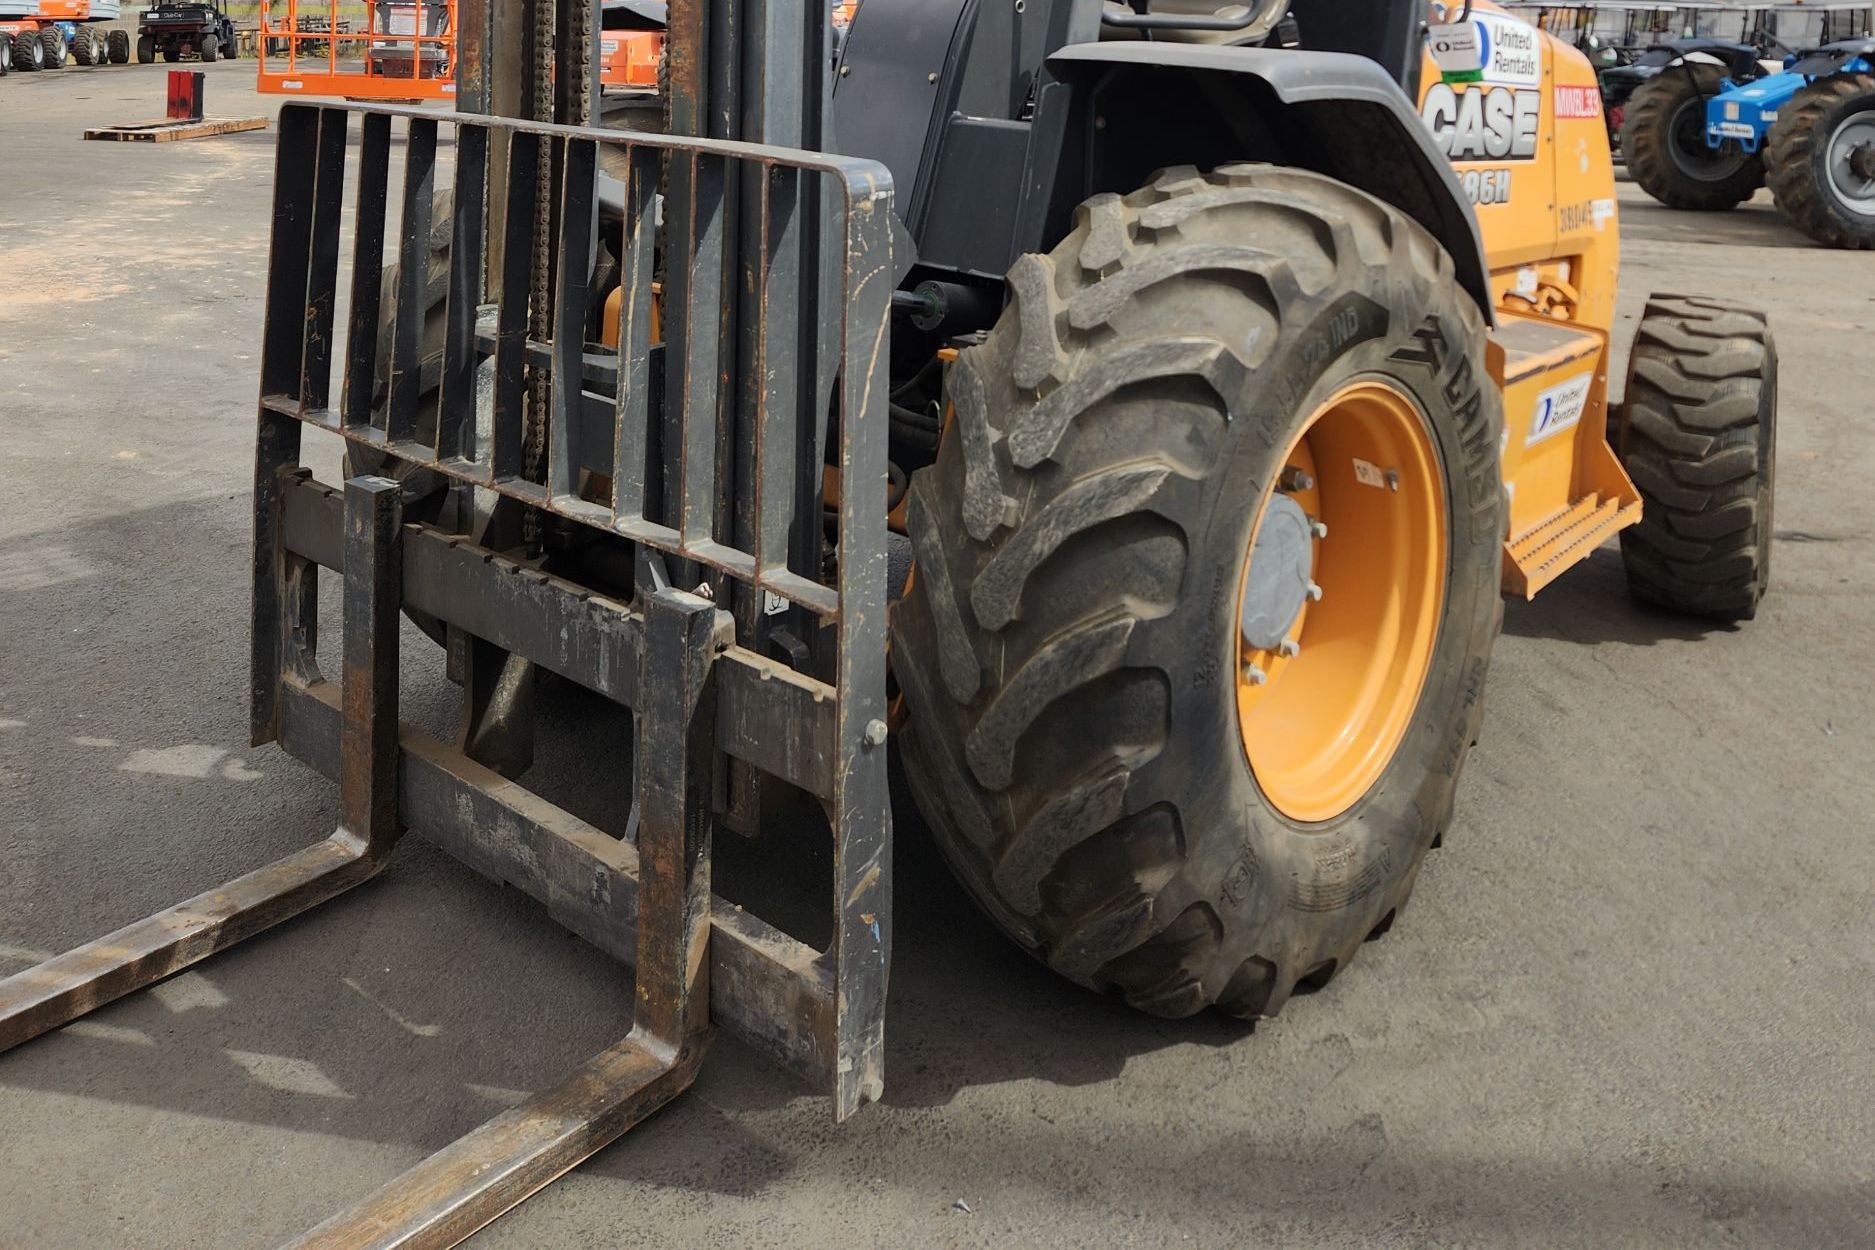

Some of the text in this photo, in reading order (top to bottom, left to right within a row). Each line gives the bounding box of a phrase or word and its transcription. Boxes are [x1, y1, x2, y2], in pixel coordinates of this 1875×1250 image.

[1493, 24, 1533, 51] United
[1493, 51, 1536, 77] Rentals
[1421, 82, 1541, 158] CASE
[1456, 168, 1511, 205] 86H
[1329, 306, 1360, 350] IND
